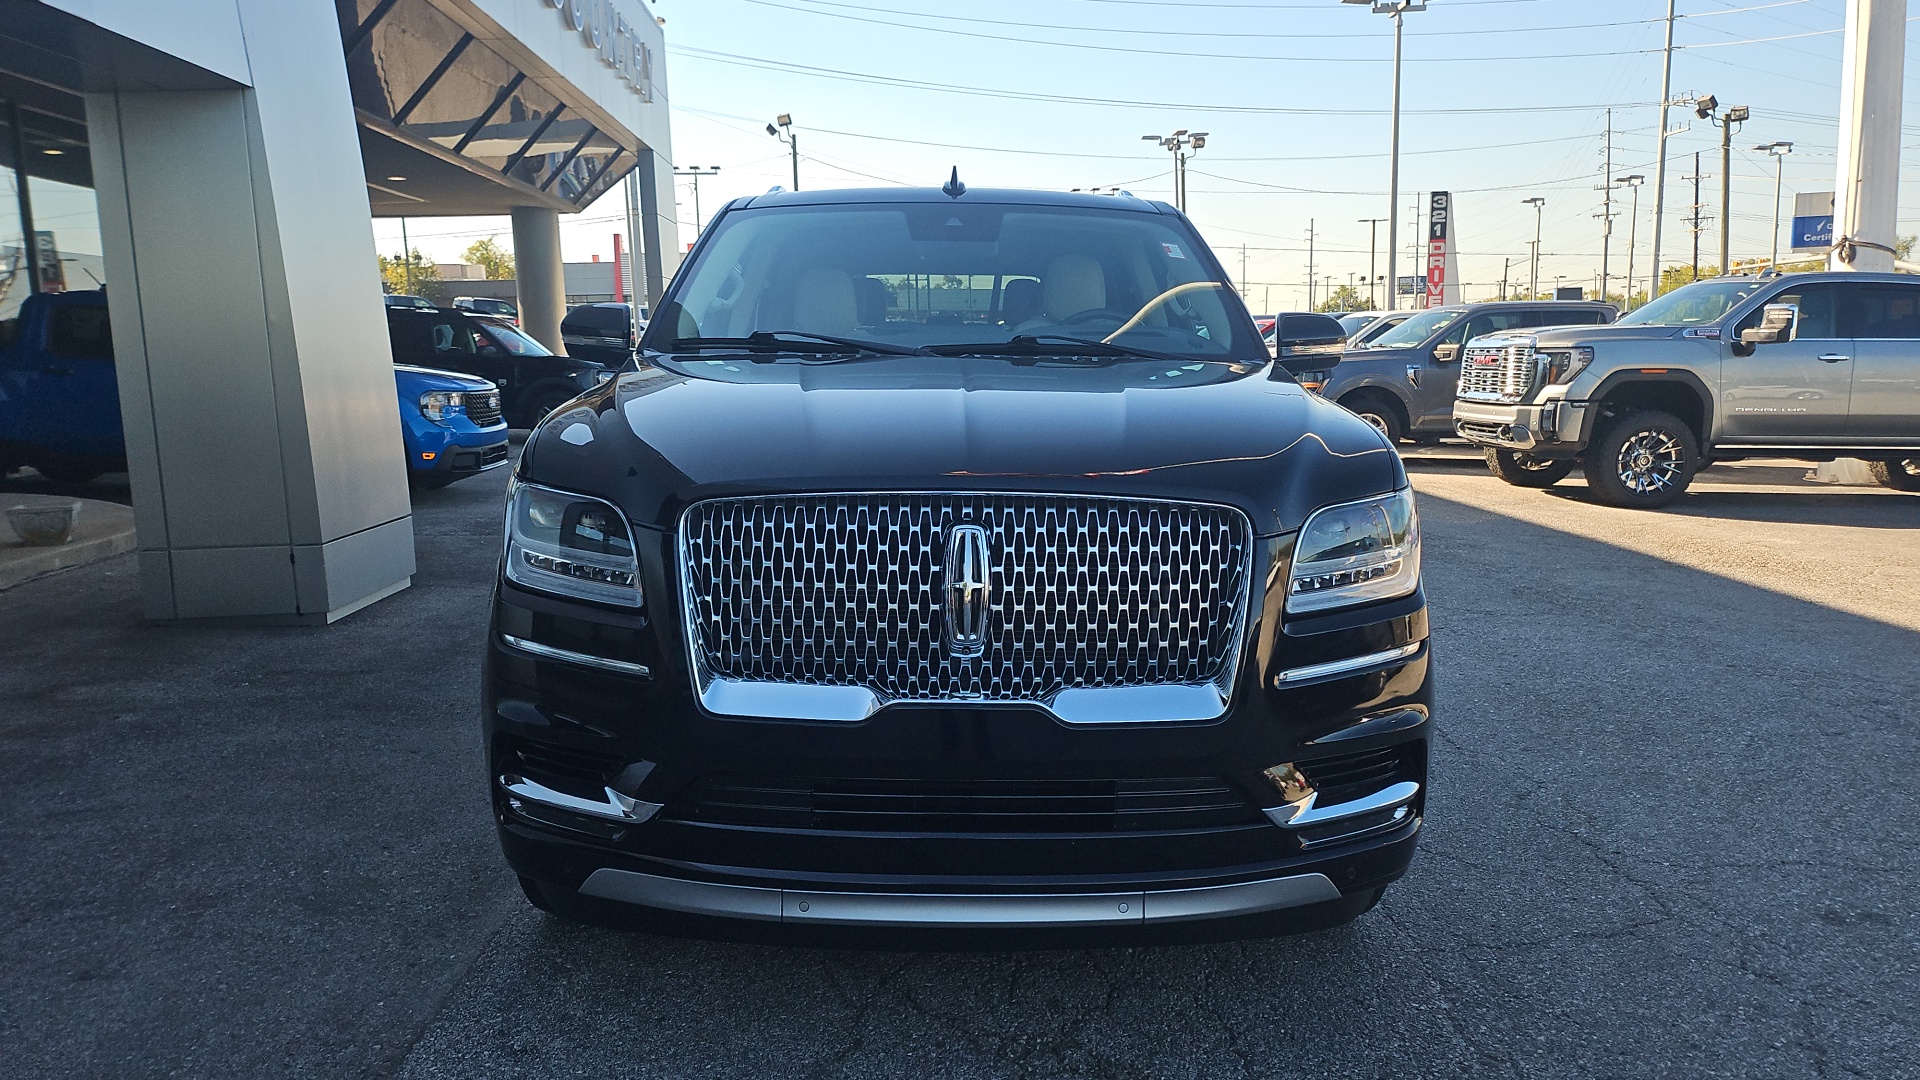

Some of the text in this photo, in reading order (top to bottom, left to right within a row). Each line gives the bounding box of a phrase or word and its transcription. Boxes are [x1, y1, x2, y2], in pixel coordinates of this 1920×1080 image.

[541, 0, 654, 104] UNTRY
[1427, 195, 1447, 308] 321 DRIVE
[1473, 355, 1500, 365] GMC
